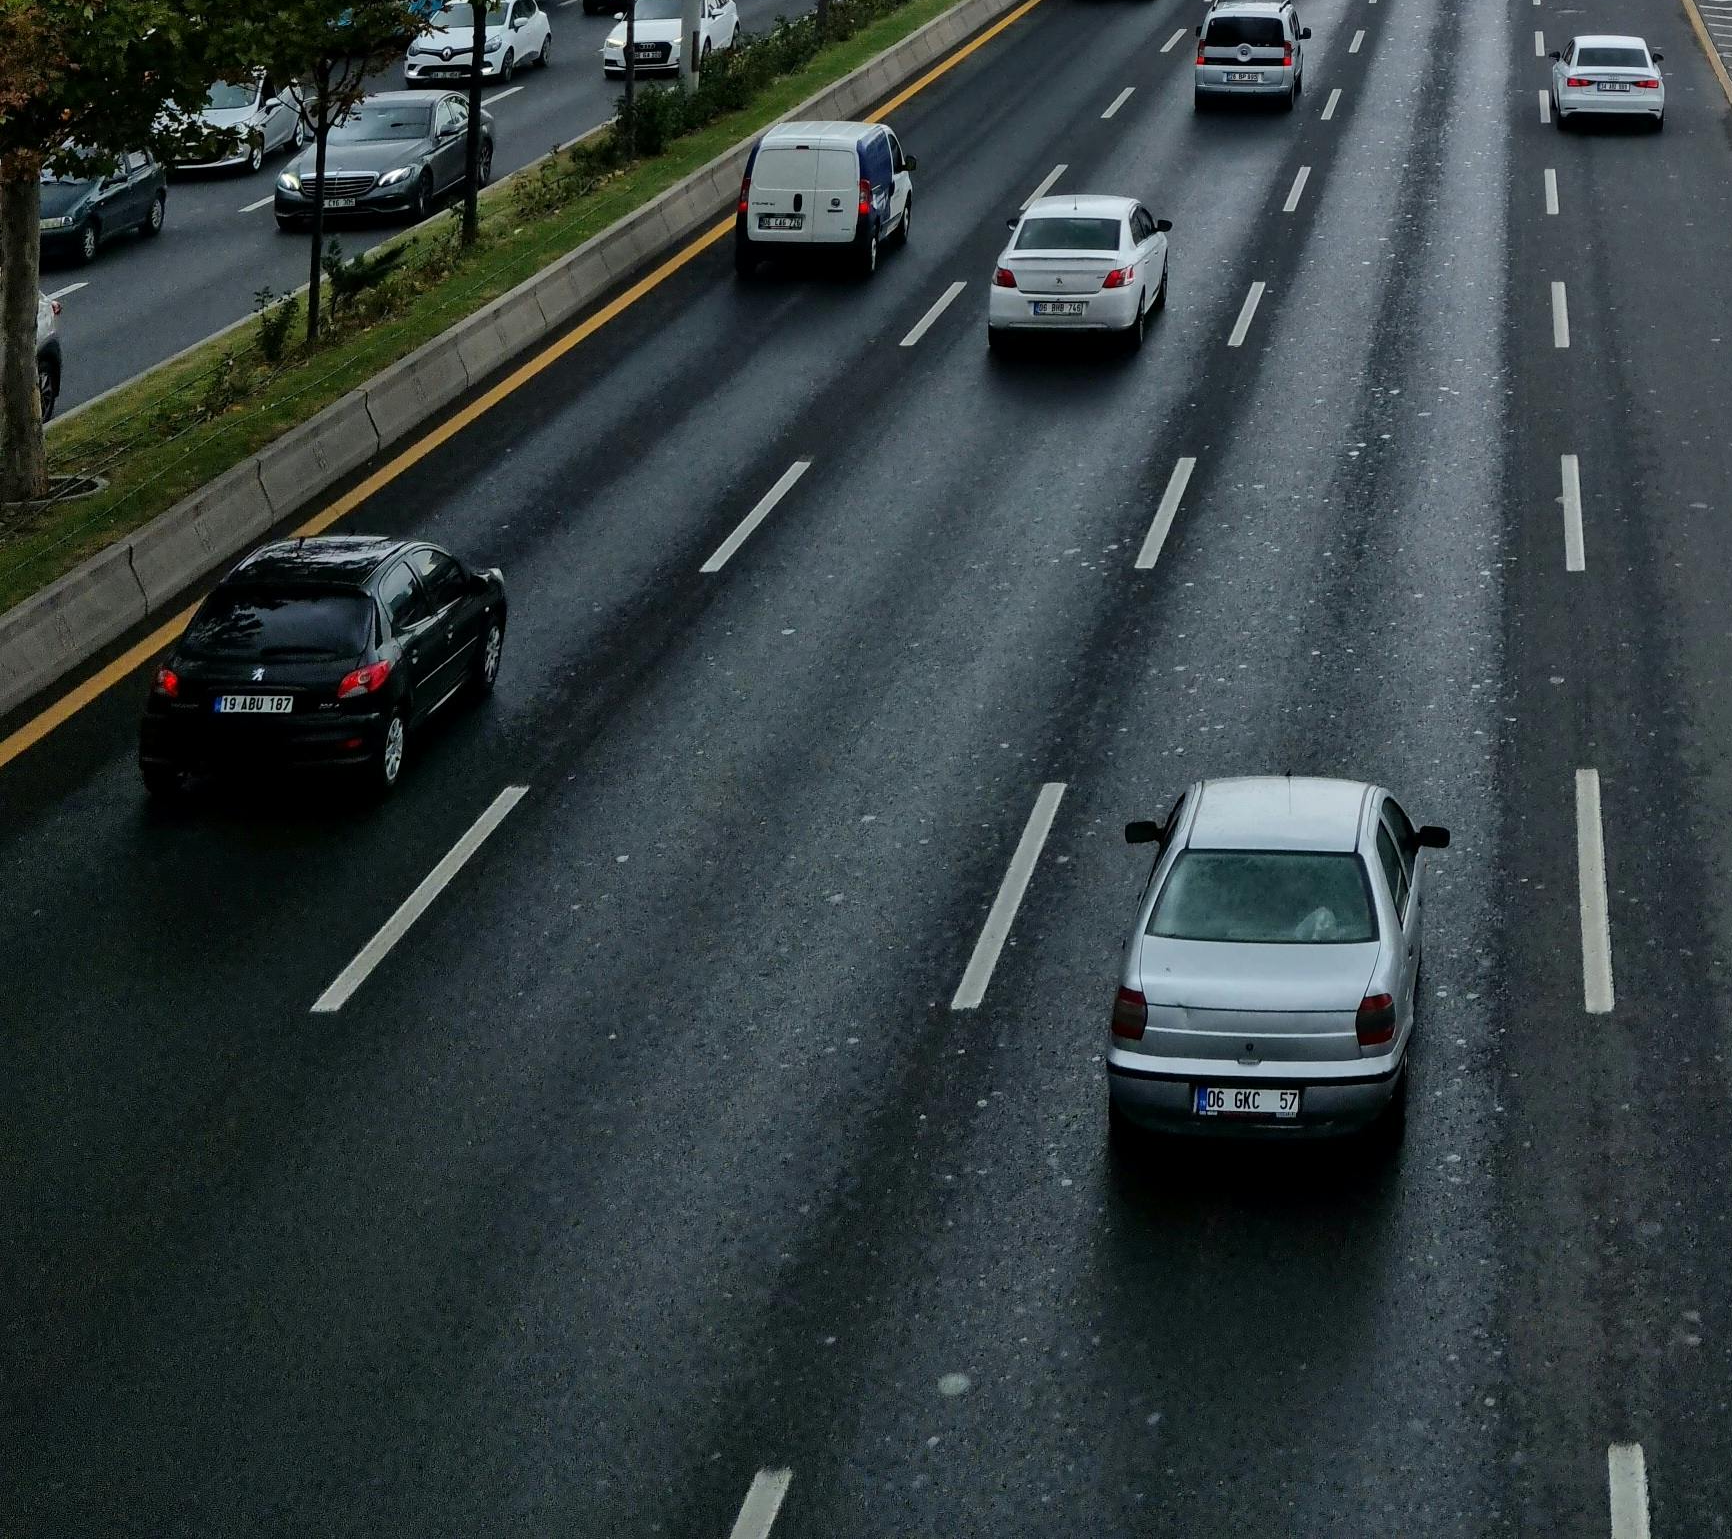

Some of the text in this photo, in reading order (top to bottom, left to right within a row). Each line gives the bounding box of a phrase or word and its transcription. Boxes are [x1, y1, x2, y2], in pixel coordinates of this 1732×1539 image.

[223, 697, 292, 711] 19 ABU 187
[1207, 1090, 1298, 1110] 06 GKC 57
